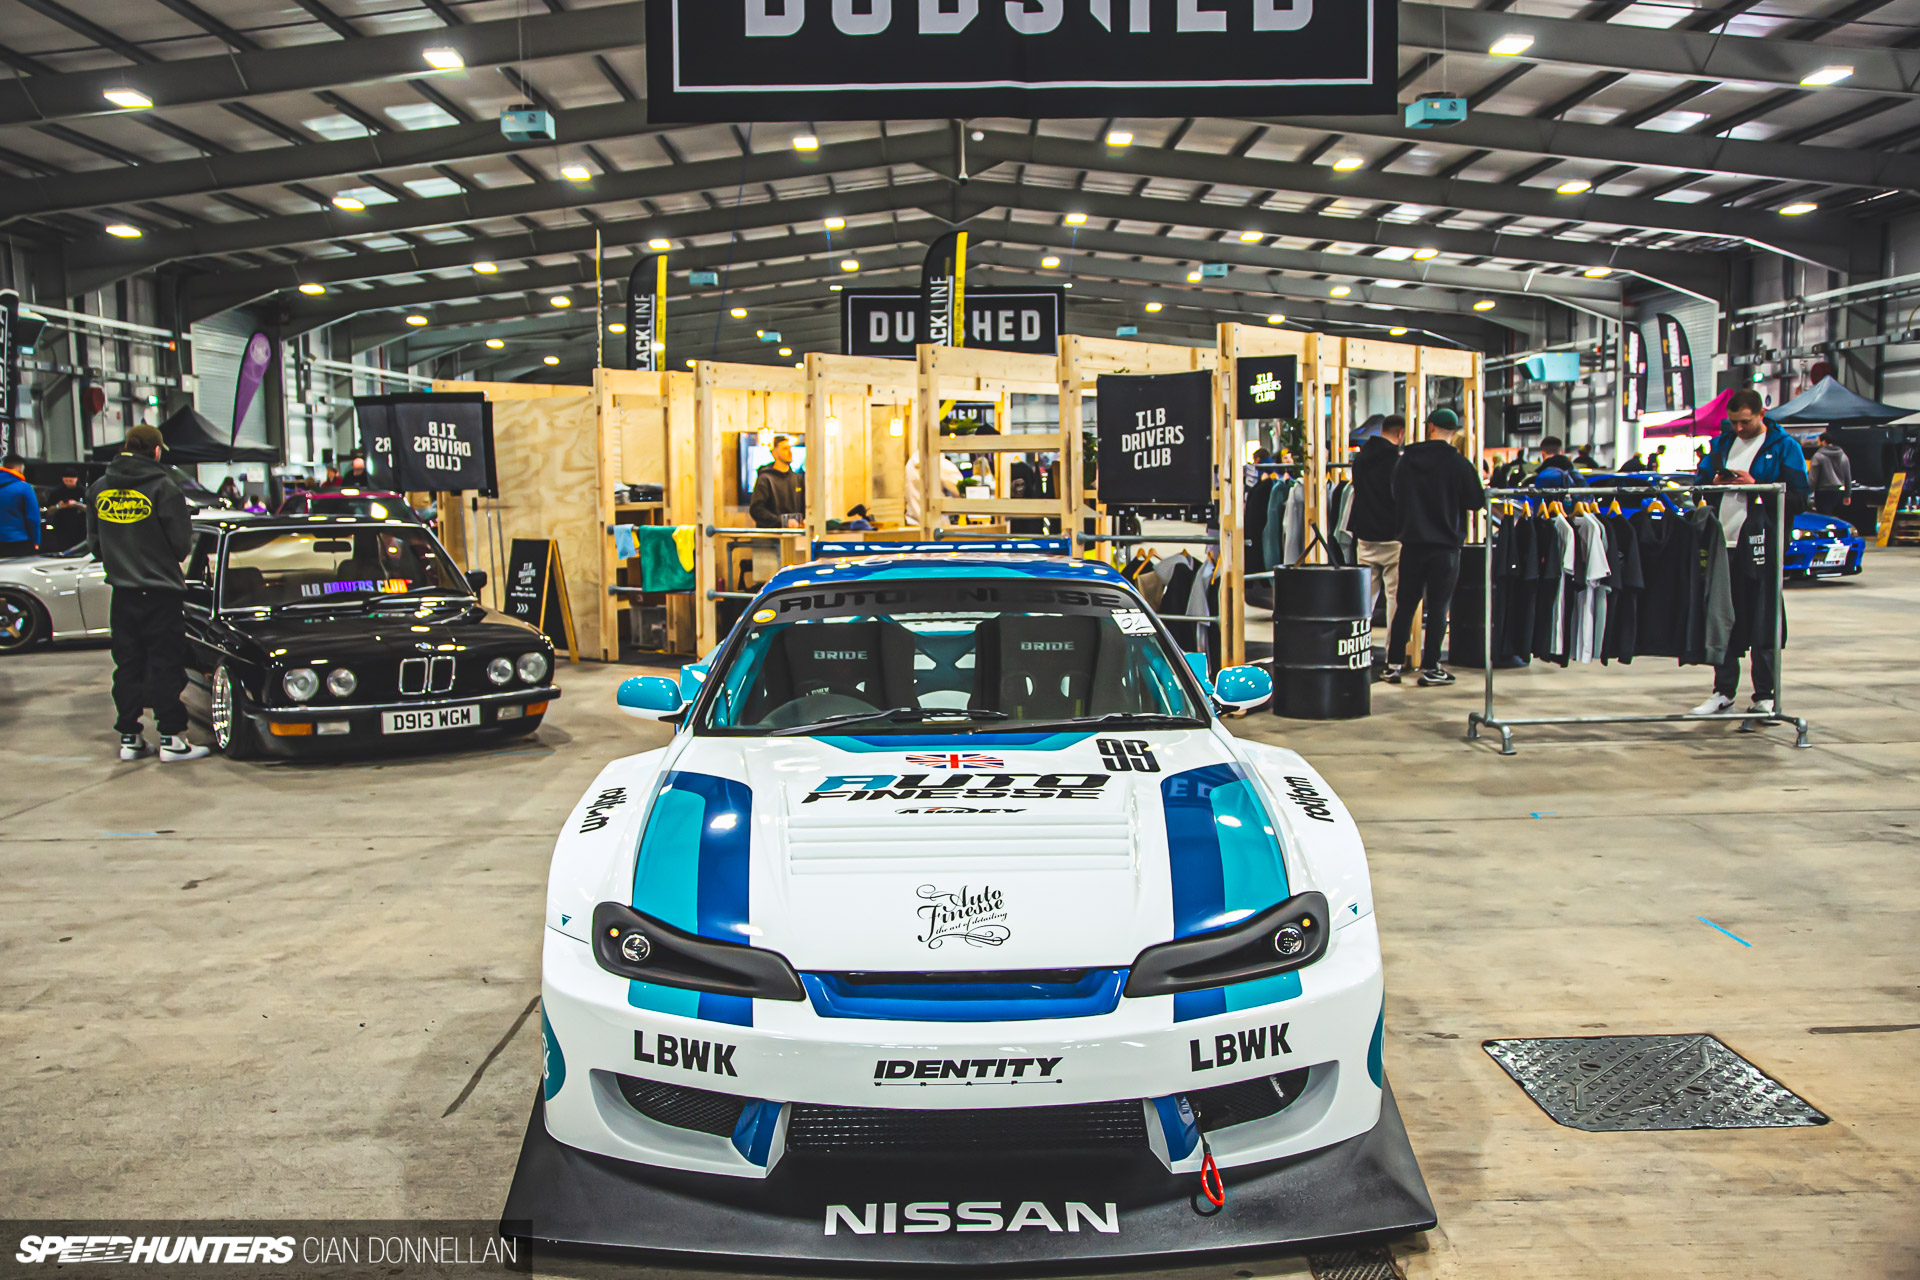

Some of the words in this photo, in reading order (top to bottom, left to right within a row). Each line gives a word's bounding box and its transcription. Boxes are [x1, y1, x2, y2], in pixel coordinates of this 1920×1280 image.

[930, 275, 949, 347] ACKLINE
[634, 292, 651, 372] LACKLINE
[869, 310, 1041, 343] DUHED
[1135, 407, 1166, 431] ILB
[1121, 425, 1185, 453] DRIVERS
[1133, 447, 1171, 470] CLUB
[779, 587, 1121, 613] AUTONSSE
[814, 650, 868, 660] BRIDE
[1021, 641, 1075, 651] BRIDE
[1338, 632, 1372, 656] DRIVE
[393, 712, 434, 731] D913
[439, 707, 471, 727] WGM
[1097, 739, 1160, 772] 99
[801, 788, 1105, 804] FINESSE
[813, 774, 1111, 792] AUTO
[932, 884, 1003, 911] Auto
[917, 899, 1004, 942] Finesse
[936, 924, 948, 935] the
[963, 917, 973, 931] of
[633, 1029, 739, 1078] LBWK
[1189, 1022, 1293, 1072] LBWK
[873, 1057, 1064, 1079] IDENTITY
[824, 1201, 1120, 1236] NISSAN
